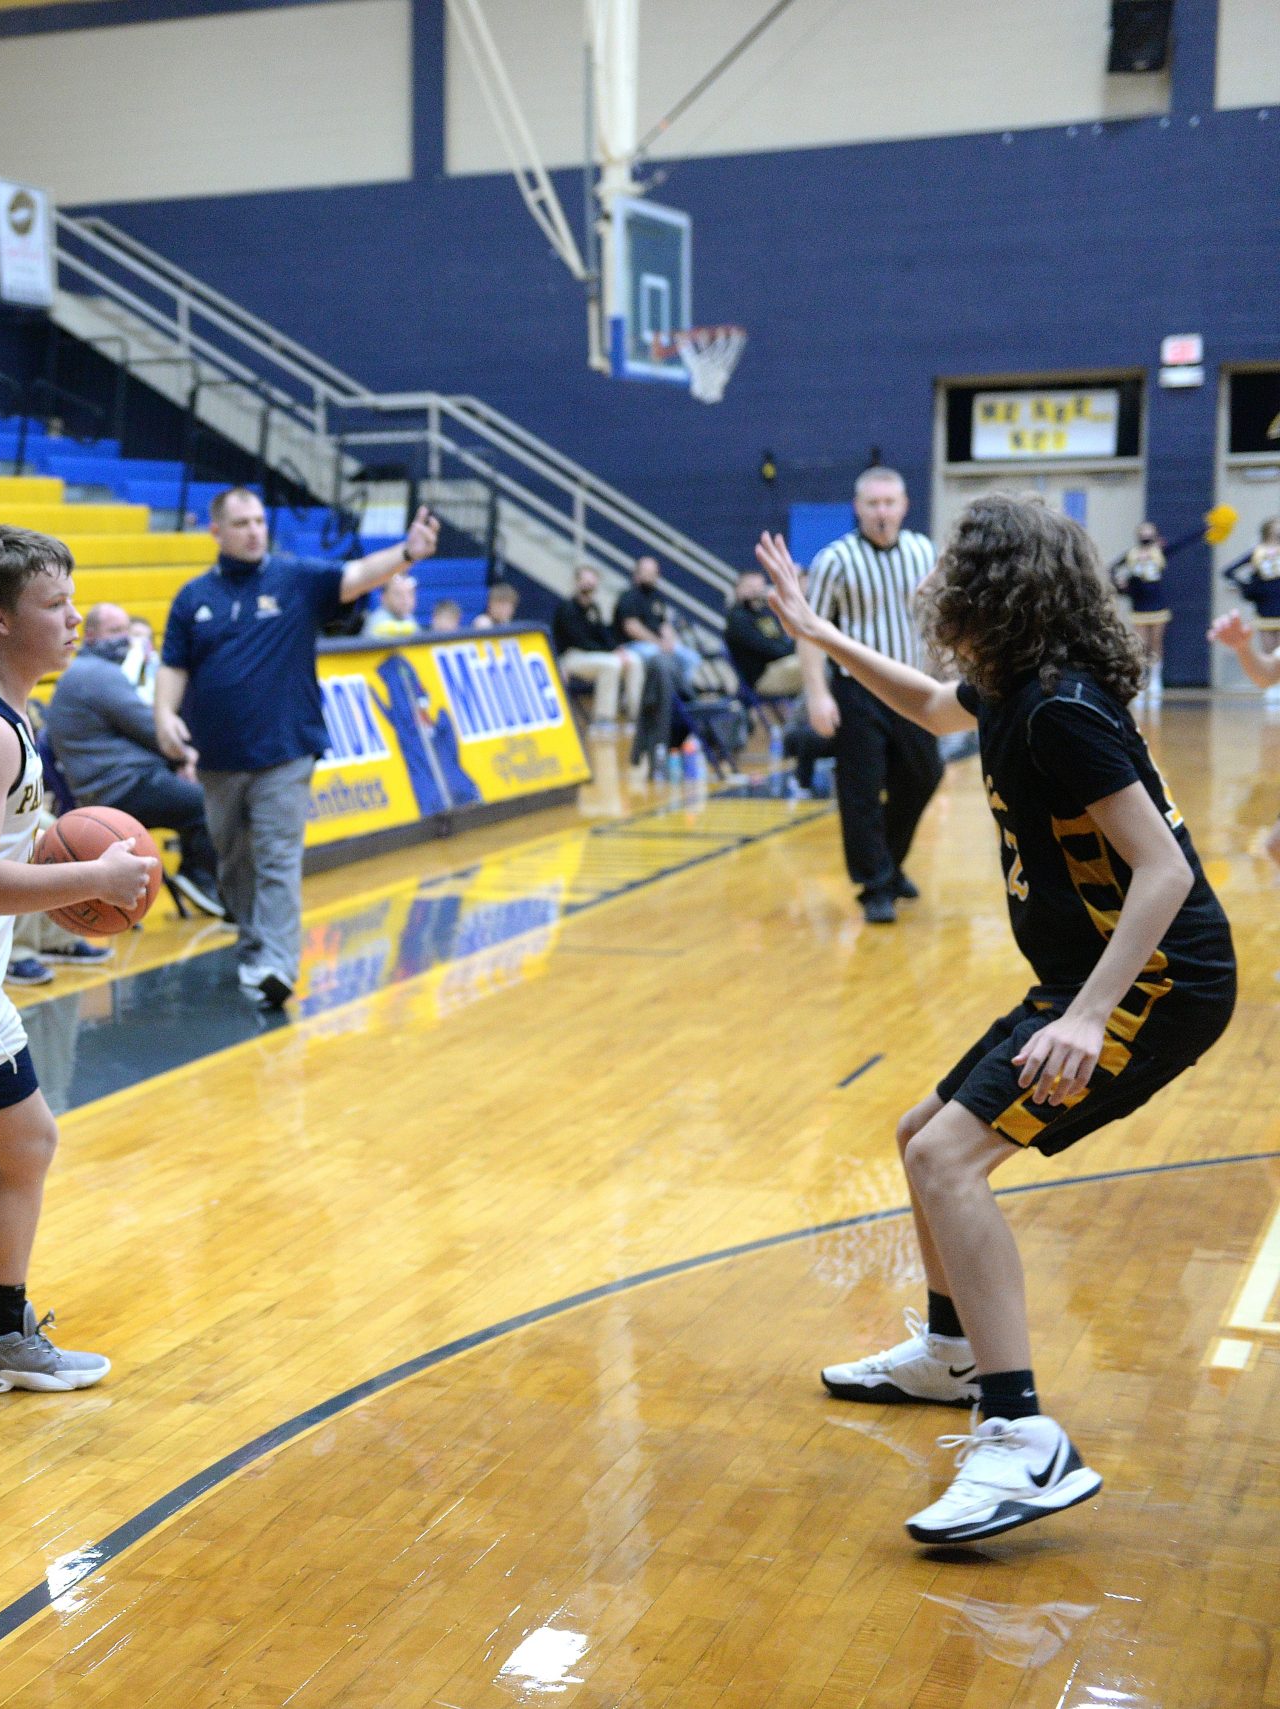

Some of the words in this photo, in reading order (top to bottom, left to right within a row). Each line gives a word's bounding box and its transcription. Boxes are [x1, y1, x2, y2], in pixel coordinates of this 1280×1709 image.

[433, 638, 563, 742] Middle
[15, 783, 42, 814] PA
[307, 776, 389, 821] anthers
